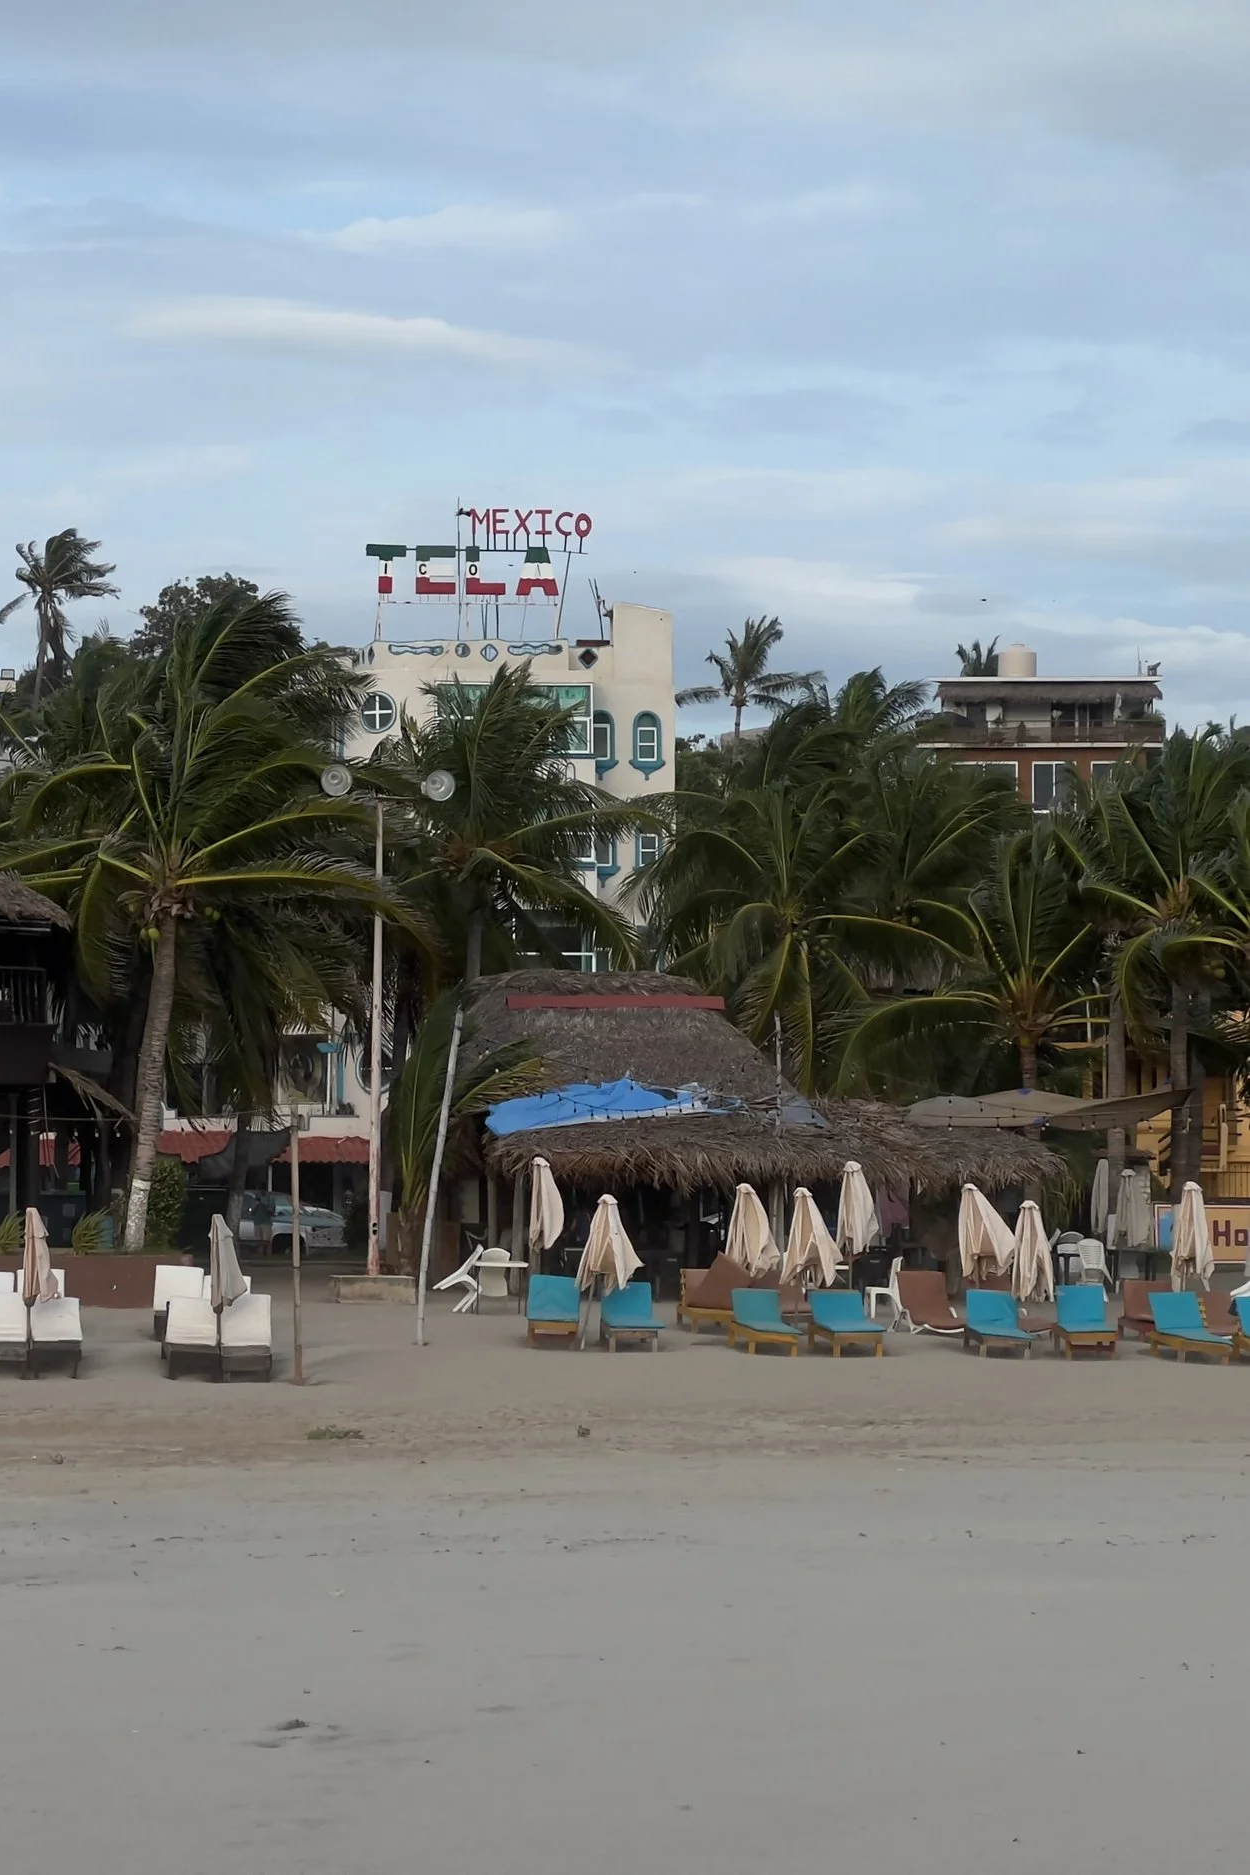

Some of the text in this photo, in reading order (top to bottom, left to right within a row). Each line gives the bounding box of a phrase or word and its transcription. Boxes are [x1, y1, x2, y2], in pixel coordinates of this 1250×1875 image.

[470, 508, 592, 538] MEXICO
[365, 543, 559, 596] TELA
[1213, 1220, 1248, 1247] Ho
